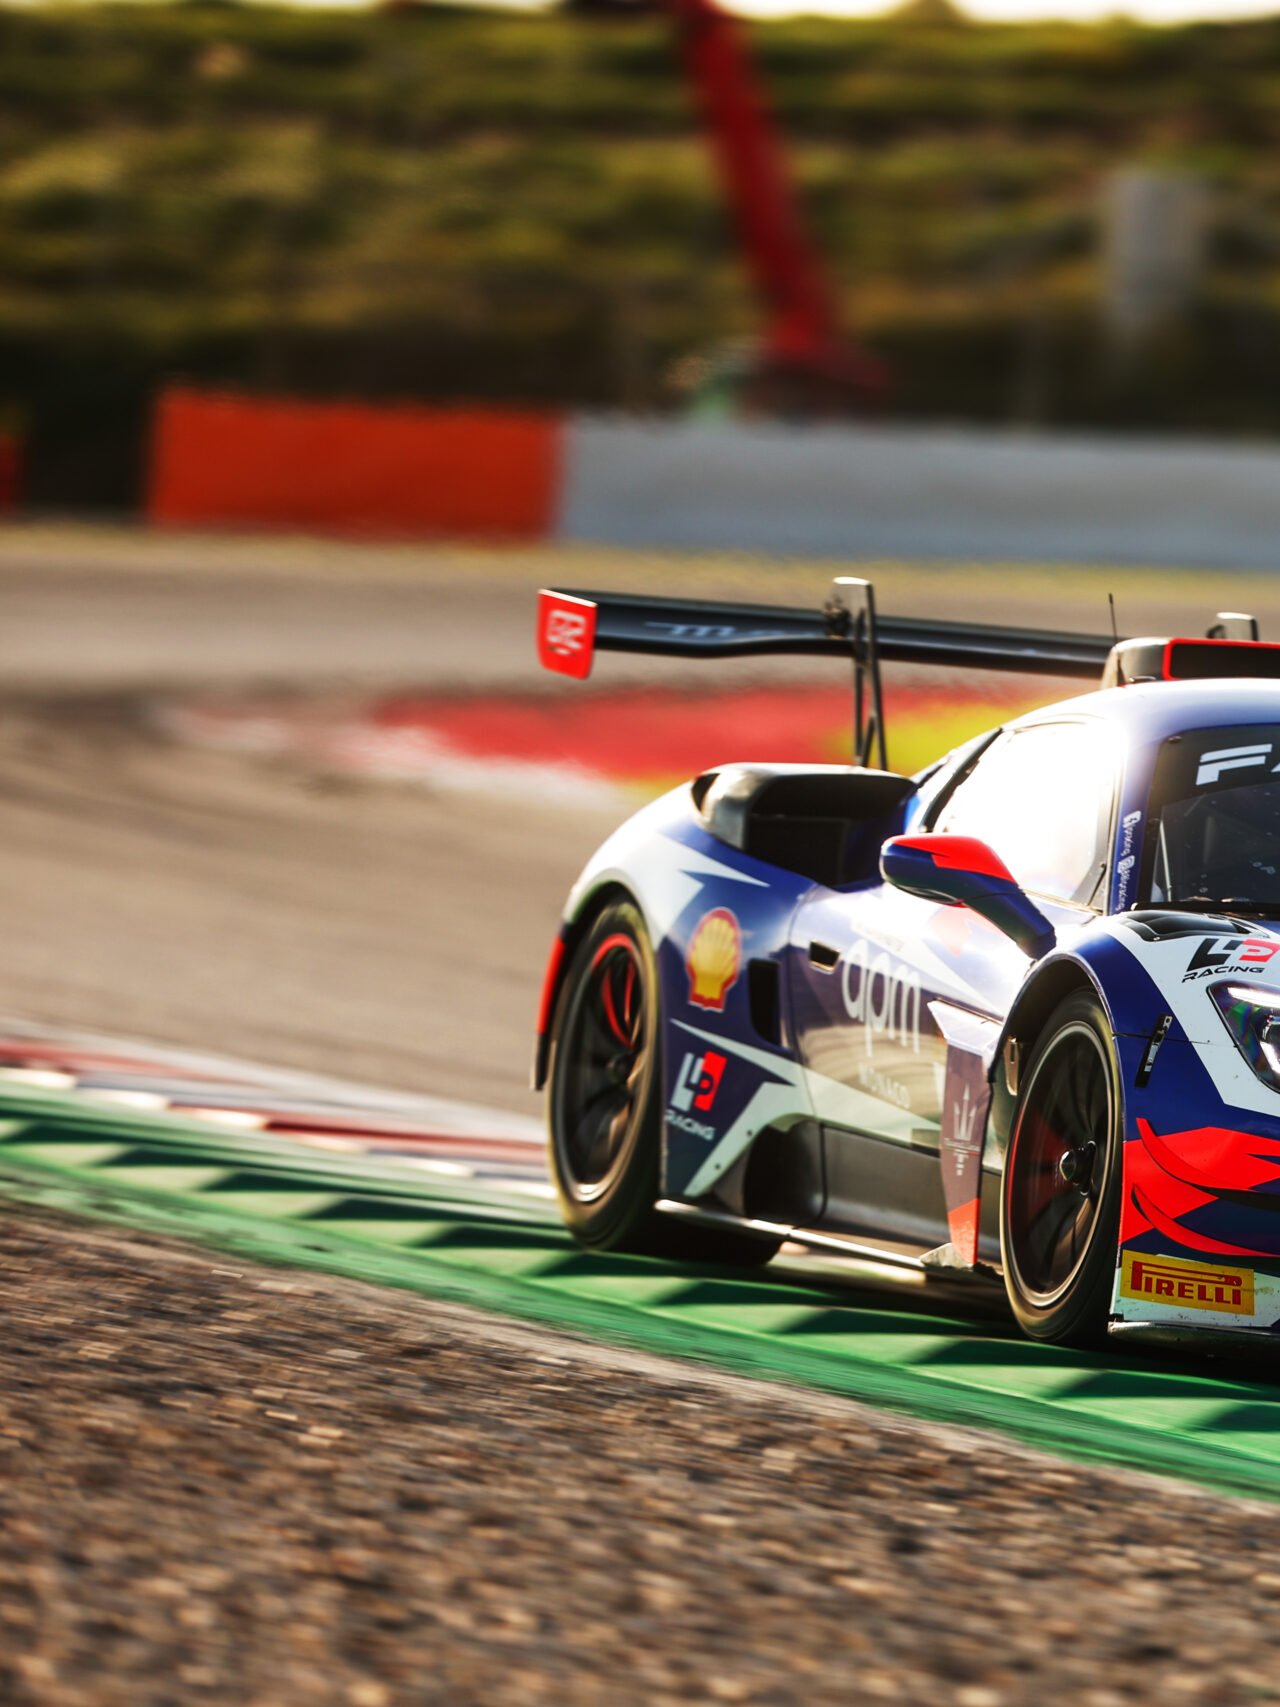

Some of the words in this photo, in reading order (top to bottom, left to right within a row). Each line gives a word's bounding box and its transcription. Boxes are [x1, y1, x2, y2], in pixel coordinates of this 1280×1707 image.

[1181, 966, 1265, 983] RACING
[840, 939, 921, 1058] apm
[665, 1109, 715, 1140] RACING
[1131, 1260, 1242, 1305] PIRELLI
